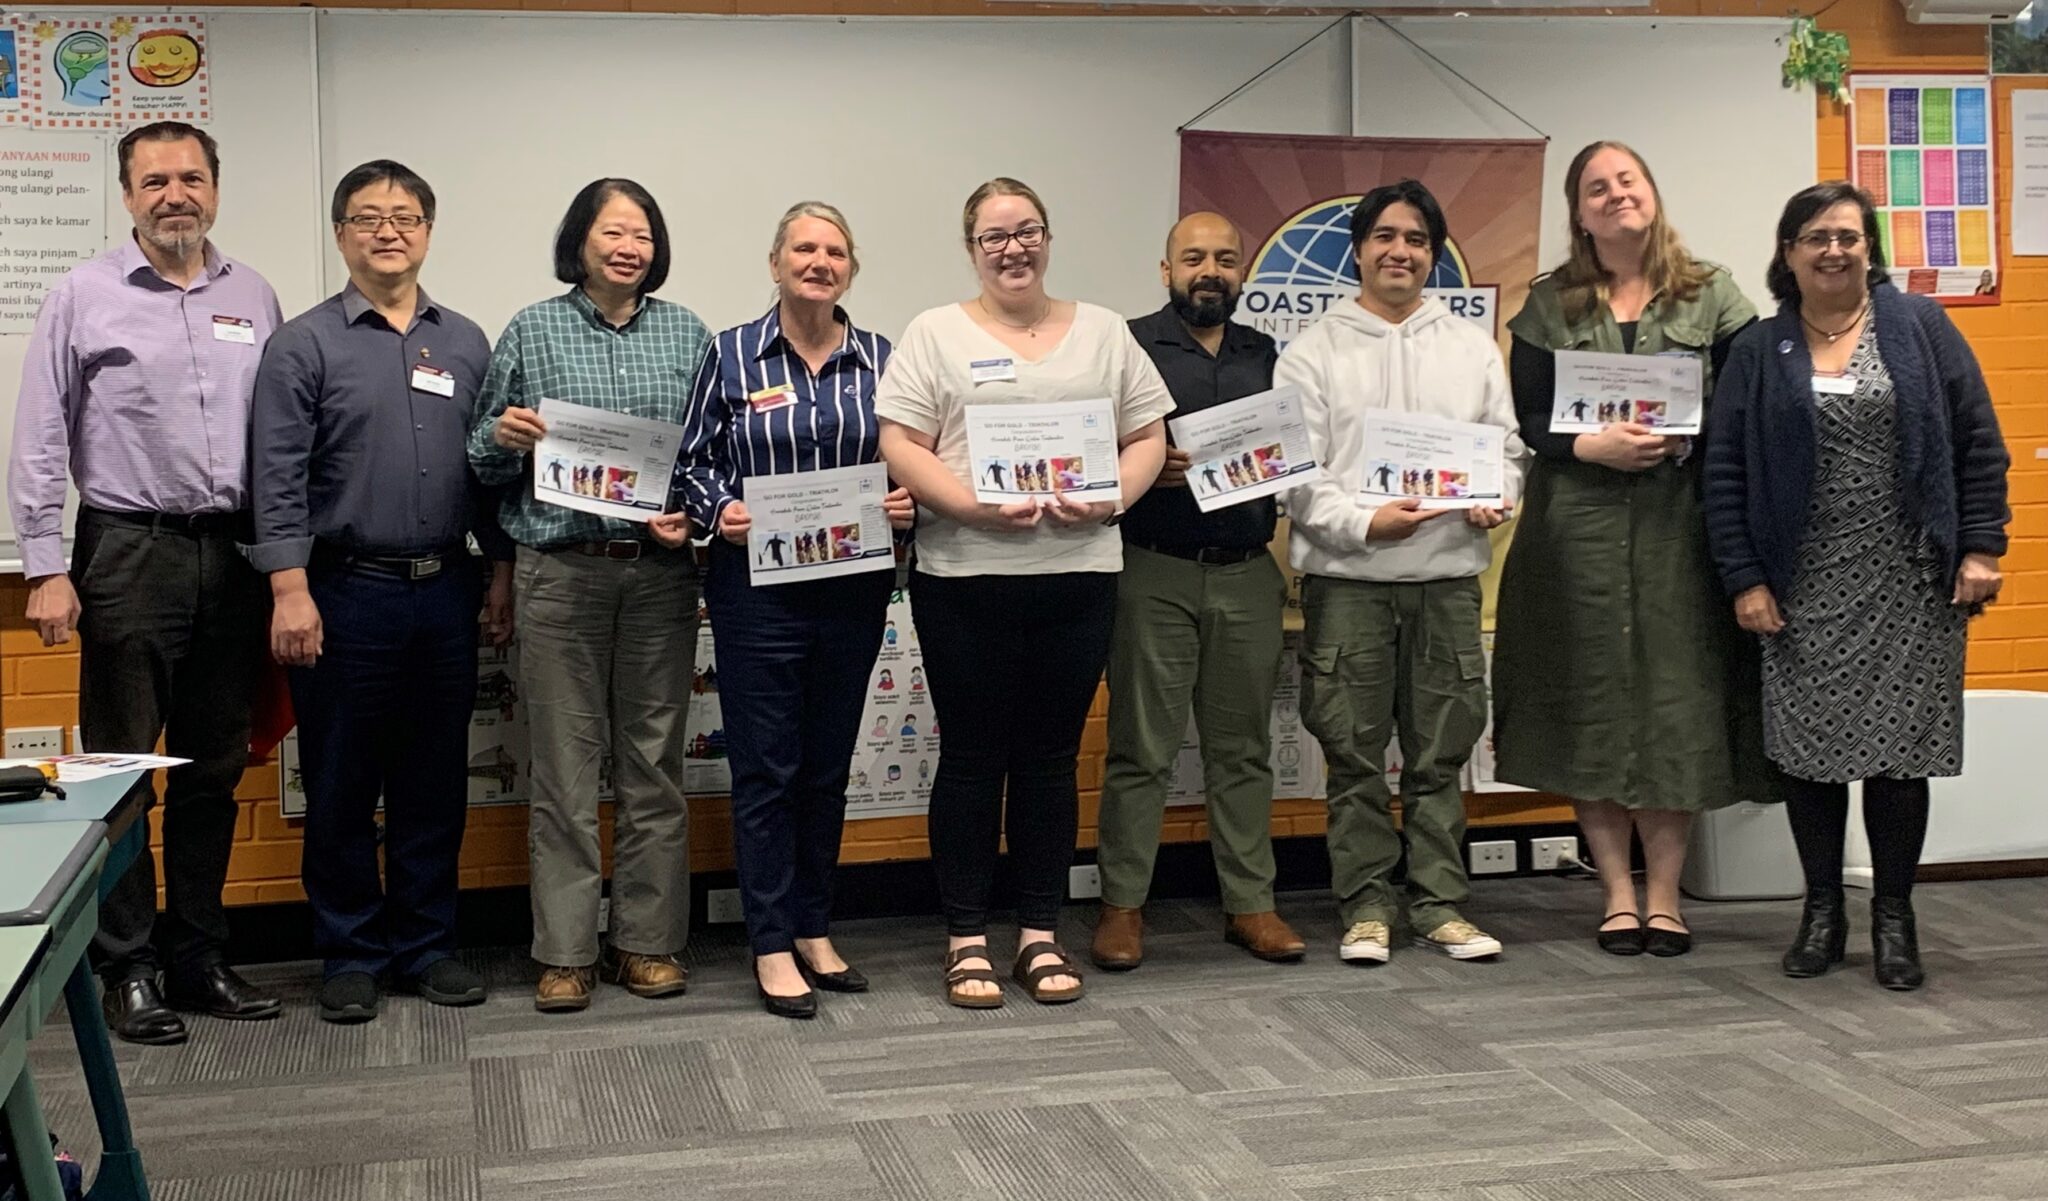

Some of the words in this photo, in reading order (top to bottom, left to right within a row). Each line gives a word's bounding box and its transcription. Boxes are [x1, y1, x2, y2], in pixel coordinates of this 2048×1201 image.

[0, 151, 49, 161] ANYAAN
[52, 152, 91, 162] MURID
[20, 168, 54, 180] ulangi
[20, 184, 54, 196] ulangi
[14, 218, 38, 227] saya
[40, 216, 54, 226] ke
[56, 216, 90, 226] kamar
[14, 249, 38, 259] saya
[40, 248, 78, 259] pinjam
[14, 266, 38, 275] saya
[3, 280, 42, 291] artinya
[4, 312, 24, 320] saya
